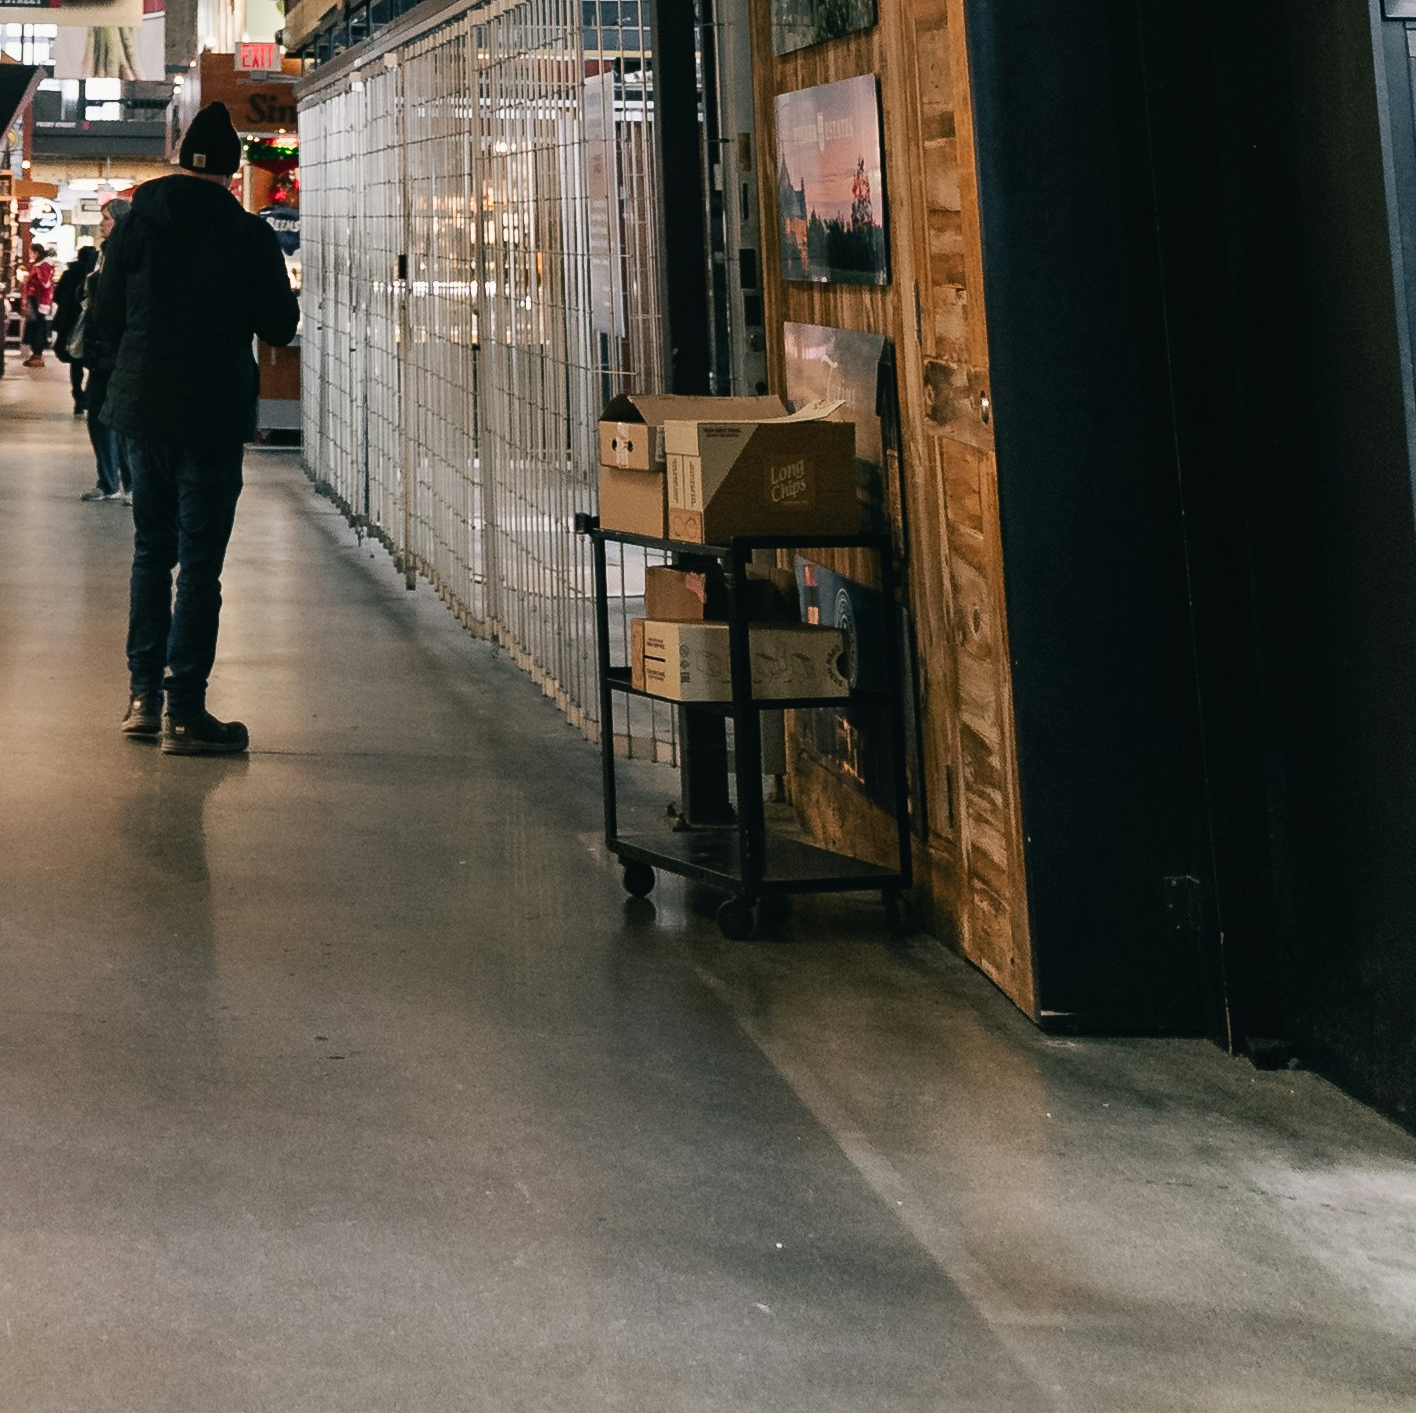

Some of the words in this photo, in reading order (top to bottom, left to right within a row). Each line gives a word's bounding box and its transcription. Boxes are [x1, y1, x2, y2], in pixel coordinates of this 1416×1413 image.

[240, 44, 275, 69] EXIT
[770, 458, 806, 487] Long
[771, 476, 806, 504] Chips
